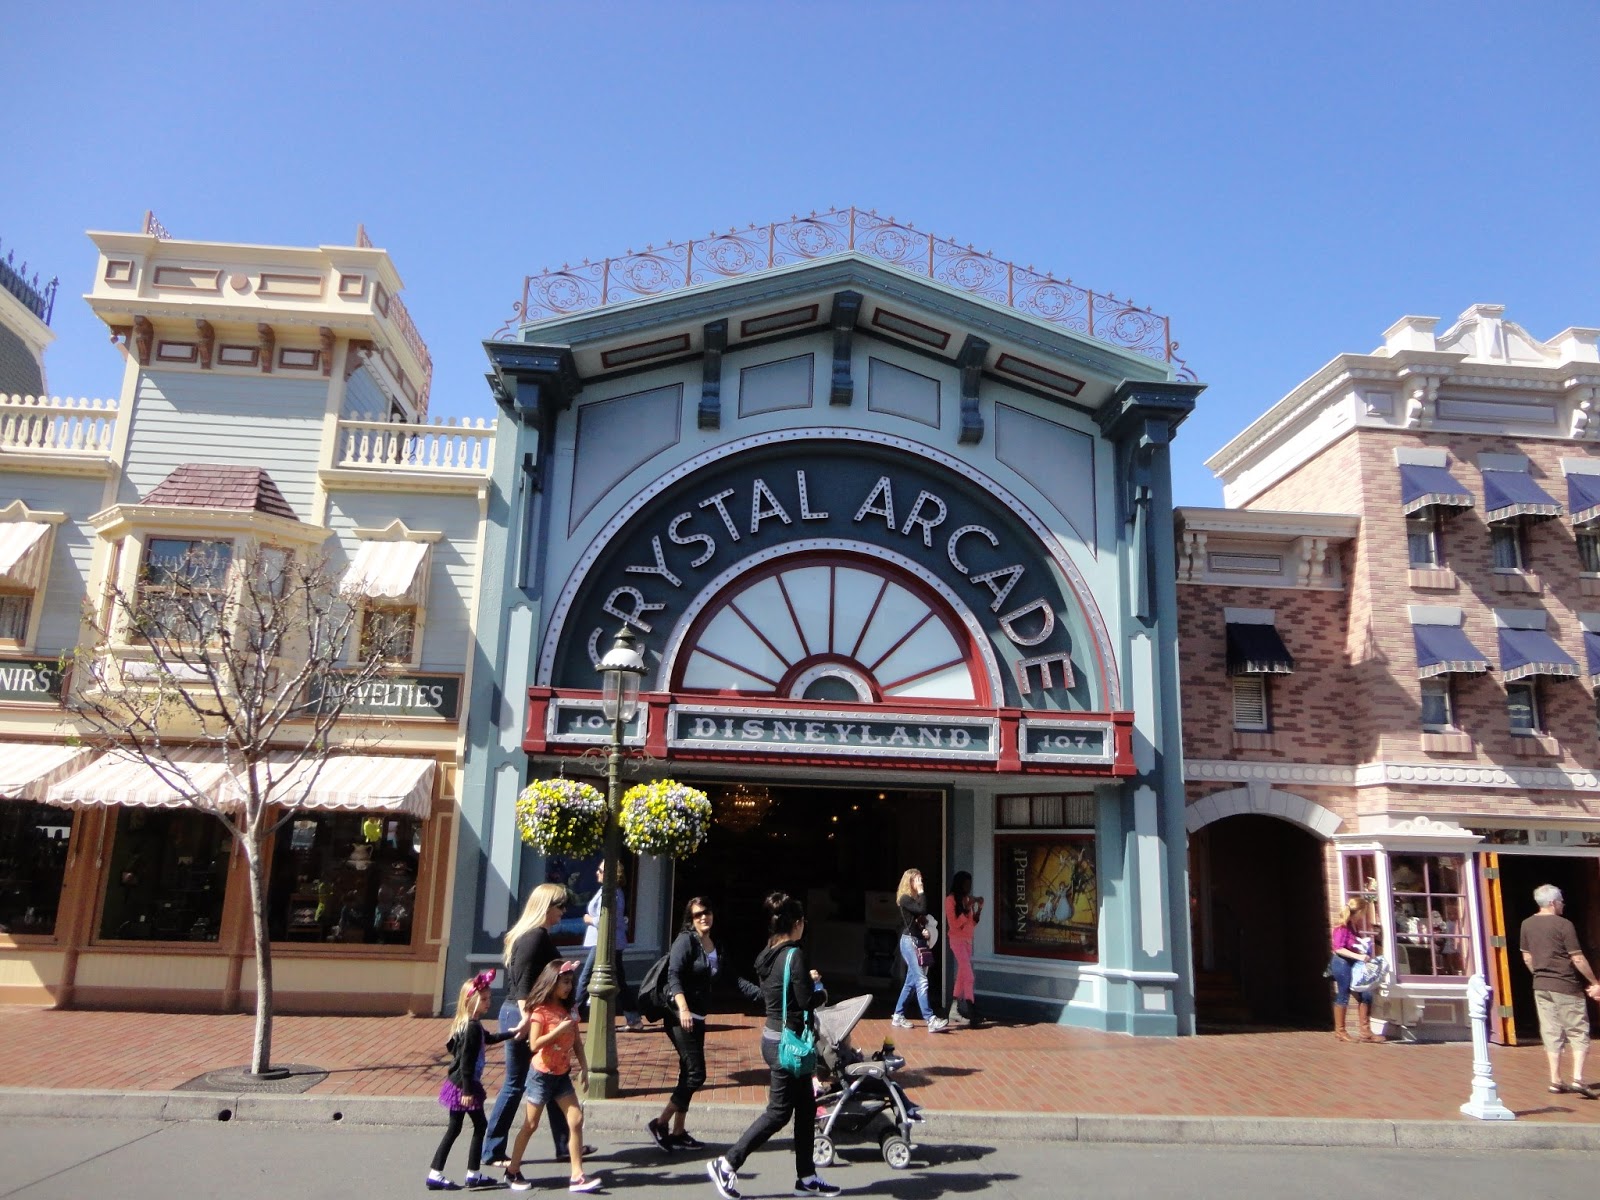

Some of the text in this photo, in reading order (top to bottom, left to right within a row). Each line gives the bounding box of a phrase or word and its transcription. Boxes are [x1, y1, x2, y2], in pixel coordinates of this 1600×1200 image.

[587, 470, 1074, 695] CRYSTAL ARCADE
[0, 667, 52, 692] NIRS
[575, 714, 620, 730] 10
[694, 717, 971, 748] DISNEYLAND
[1043, 735, 1087, 749] 107
[1014, 857, 1028, 902] PETER
[1015, 903, 1029, 933] PAN
